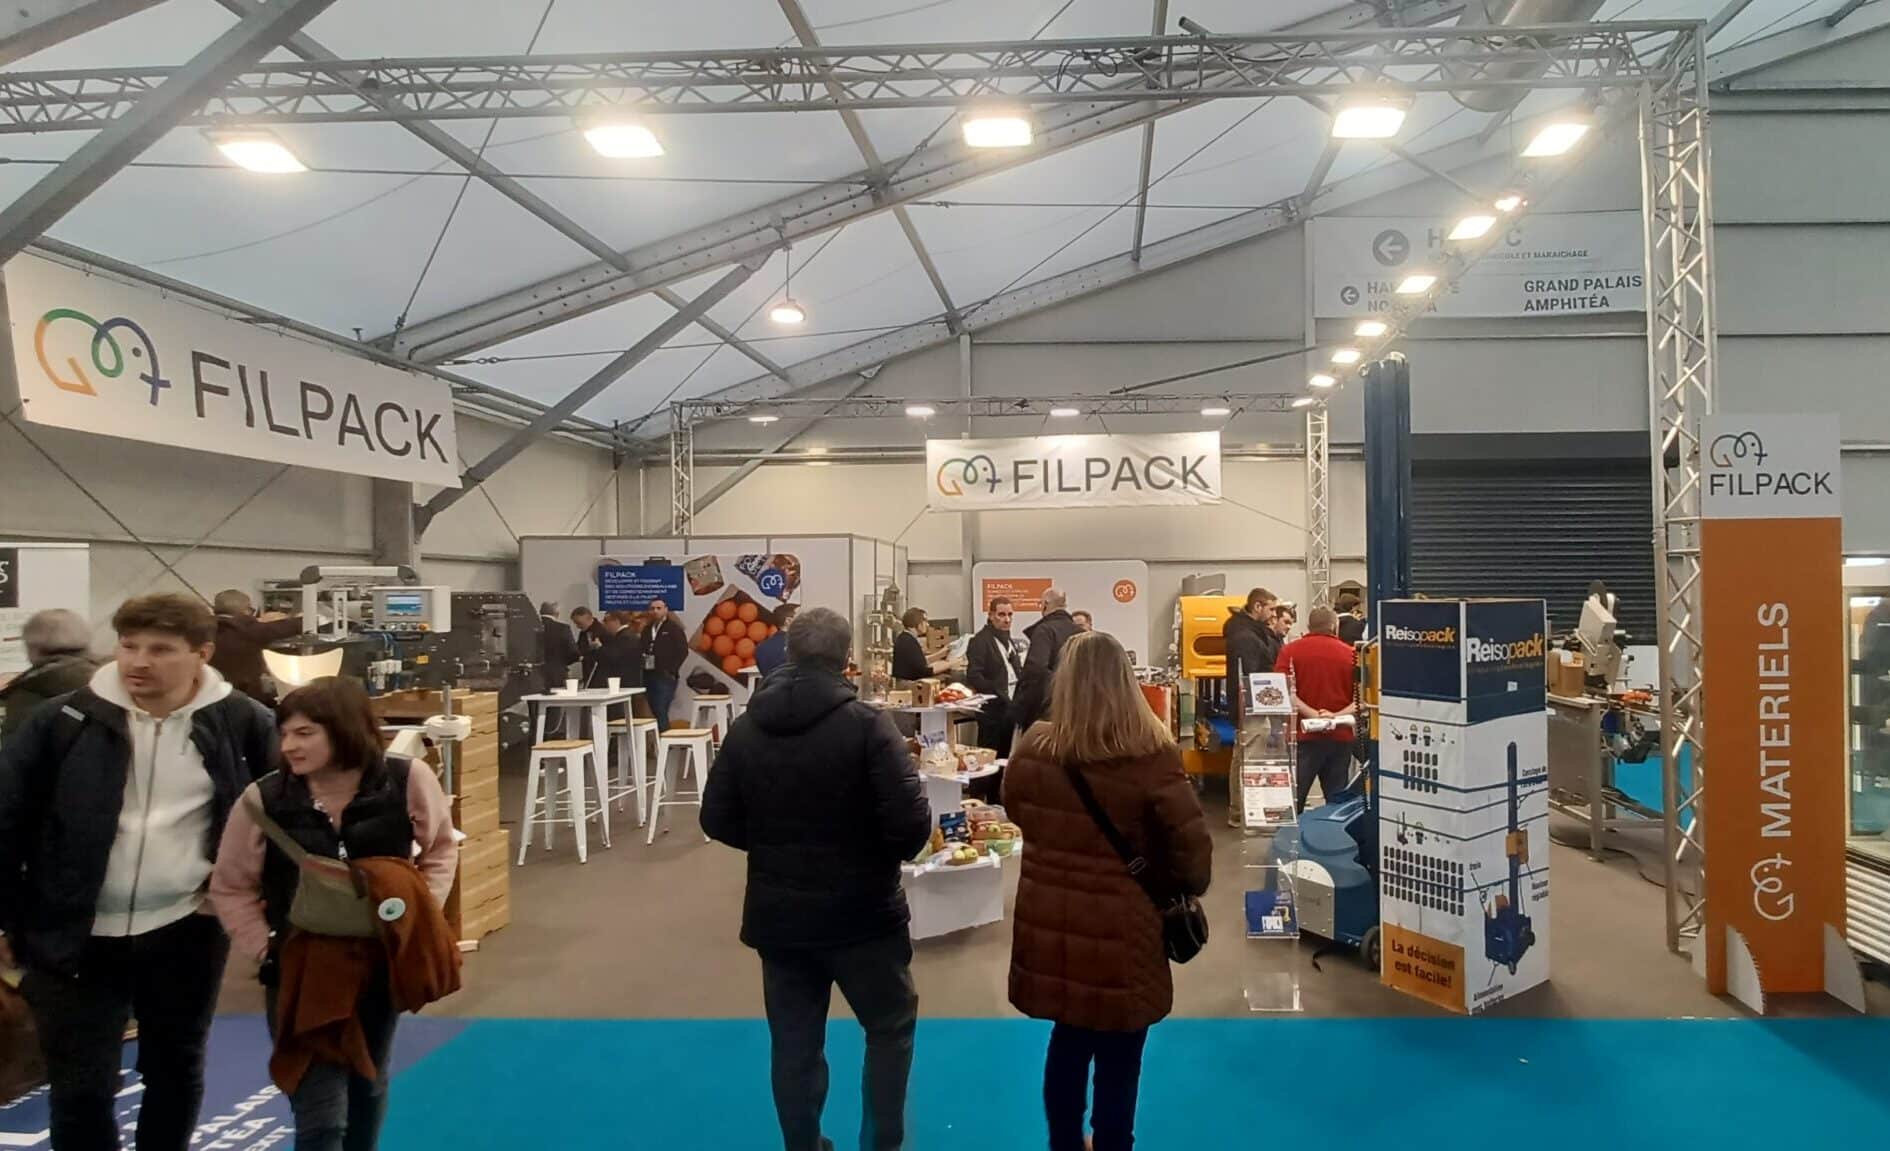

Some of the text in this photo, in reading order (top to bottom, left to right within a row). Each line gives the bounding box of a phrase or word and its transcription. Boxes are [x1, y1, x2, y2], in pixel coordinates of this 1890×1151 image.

[1524, 275, 1643, 293] GRAND PALAIS
[1524, 294, 1610, 312] AMPHITÉA
[191, 350, 448, 464] FILPACK
[1012, 455, 1212, 494] FILPACK
[1710, 471, 1833, 496] FILPACK
[1385, 625, 1456, 644] Reisopack
[1466, 633, 1544, 664] Reisopack
[1757, 602, 1792, 838] MATERIELS
[1391, 938, 1404, 954] La
[1394, 960, 1452, 989] est facile!
